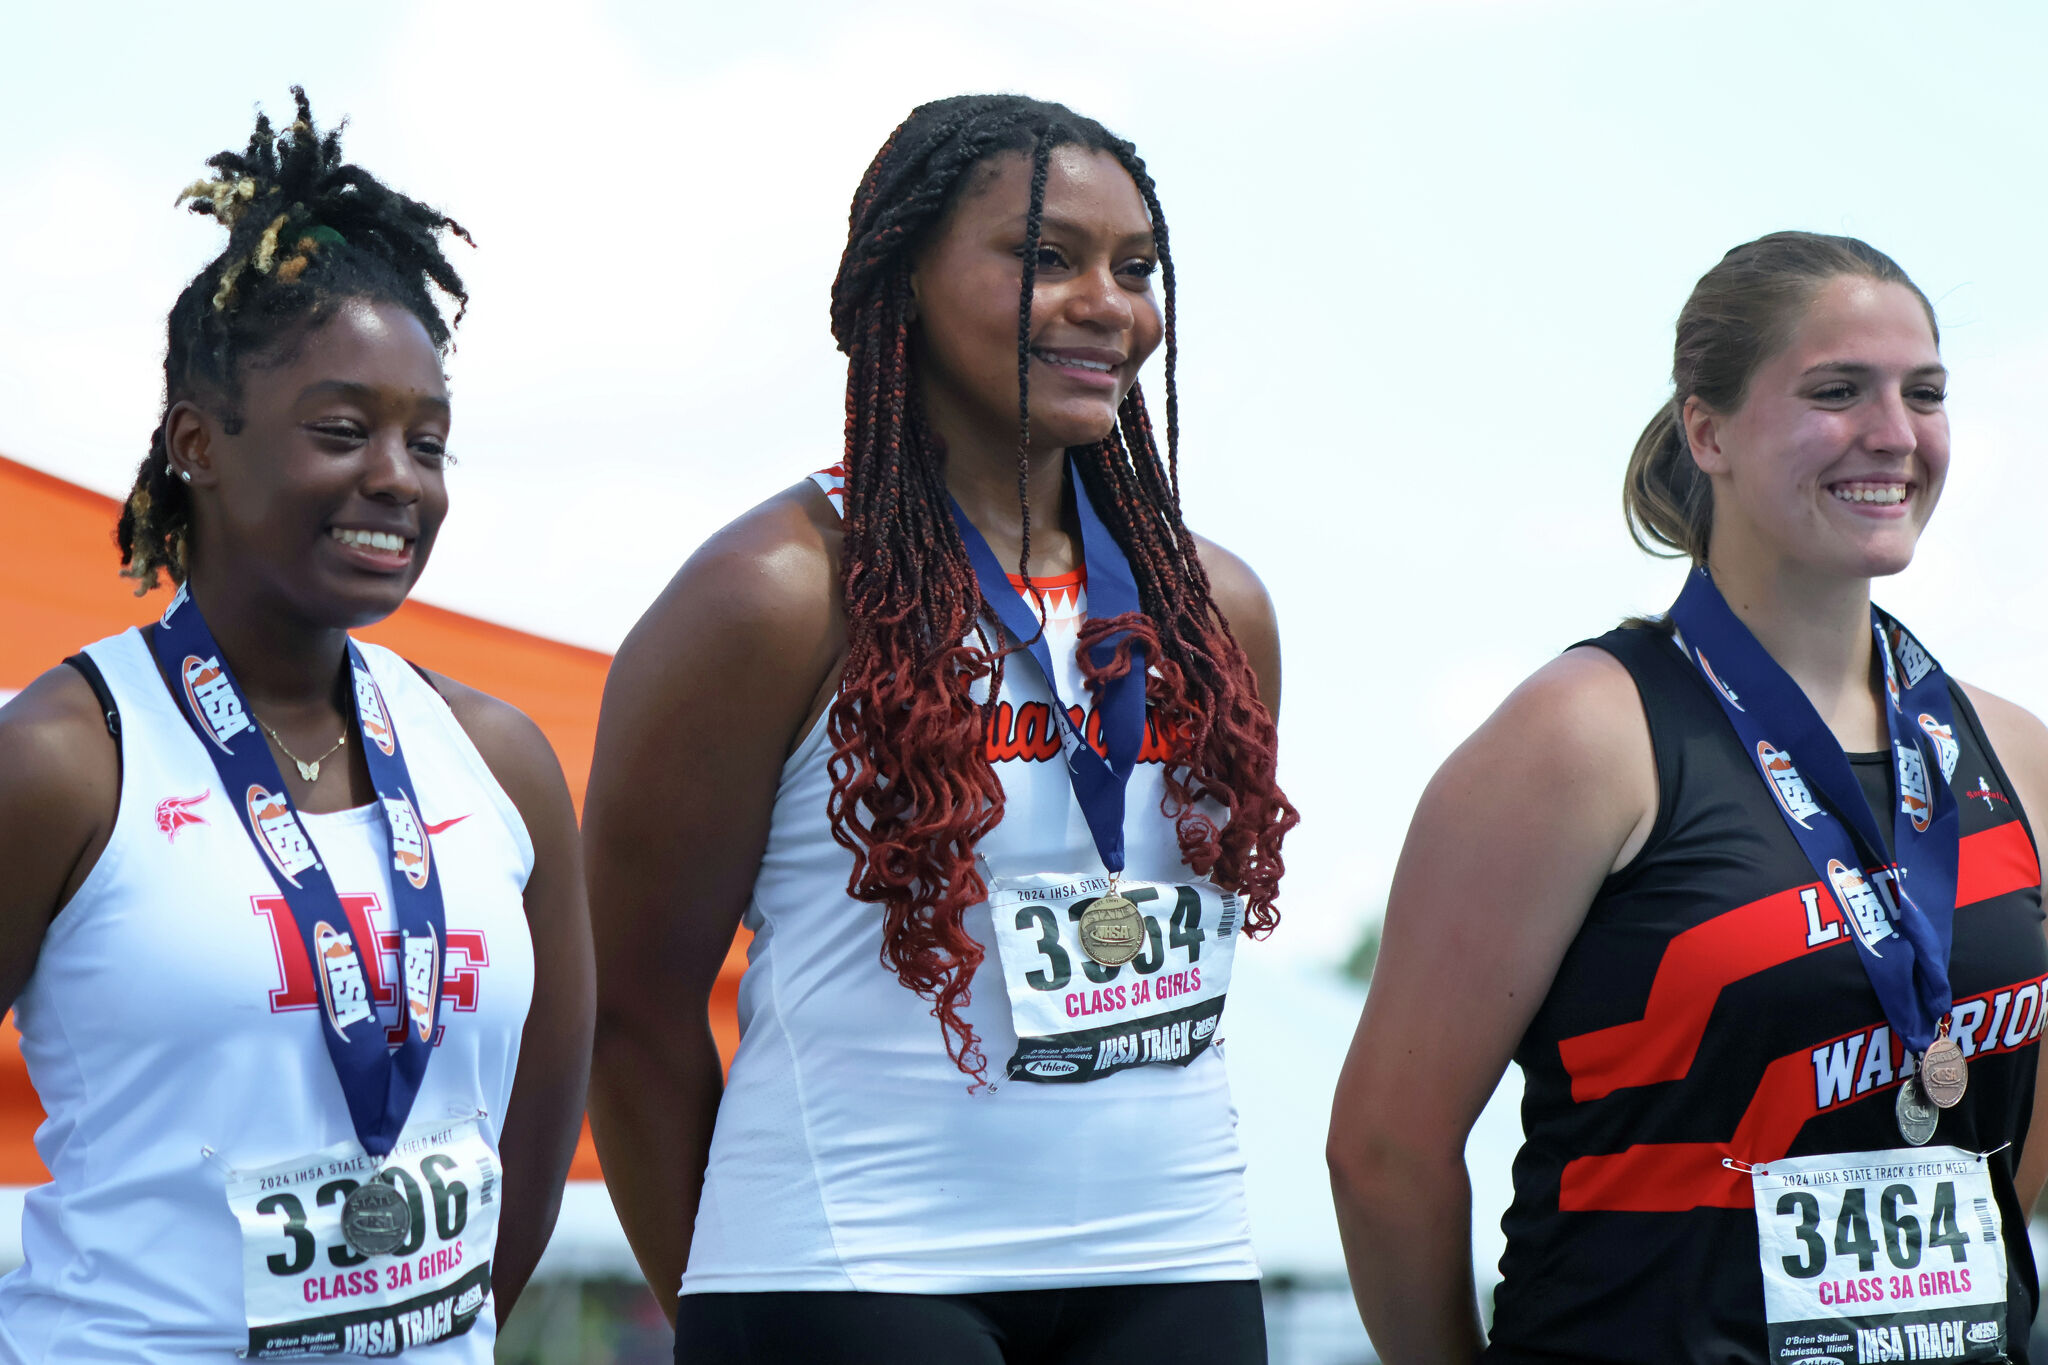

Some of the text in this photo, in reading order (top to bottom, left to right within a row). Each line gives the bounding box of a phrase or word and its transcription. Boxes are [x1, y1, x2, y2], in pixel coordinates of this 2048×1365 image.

[185, 655, 251, 743] IHSA
[1761, 750, 1822, 821] IHSA
[1896, 745, 1930, 821] IHSA
[250, 792, 318, 877] IHSA
[383, 798, 426, 877] IHSA
[1017, 878, 1109, 901] 2024 IHSA STATE
[1831, 867, 1894, 946] IHSA
[317, 931, 372, 1029] IHSA
[403, 936, 434, 1029] IHSA
[1065, 967, 1201, 1018] CLASS 3A GIRLS
[1030, 1061, 1075, 1073] Athletic
[1093, 1020, 1191, 1071] IHSA TRACK
[260, 1176, 290, 1190] 2024
[295, 1167, 324, 1182] IHSA
[329, 1157, 365, 1176] STATE
[431, 1129, 453, 1145] MEET
[1782, 1161, 1969, 1187] 2024 IHSA STATE TRACK & FIELD MEET
[1775, 1181, 1971, 1280] 3464
[303, 1240, 463, 1303] CLASS 3A GIRLS
[1818, 1268, 1973, 1306] CLASS 3A GIRLS
[301, 1332, 336, 1344] Stadium
[343, 1299, 454, 1356] IHSA TRACK
[1780, 1343, 1854, 1357] Charleston, Illinois
[1785, 1332, 1850, 1346] O'Brien Stadium
[1856, 1320, 1965, 1364] IHSA TRACK
